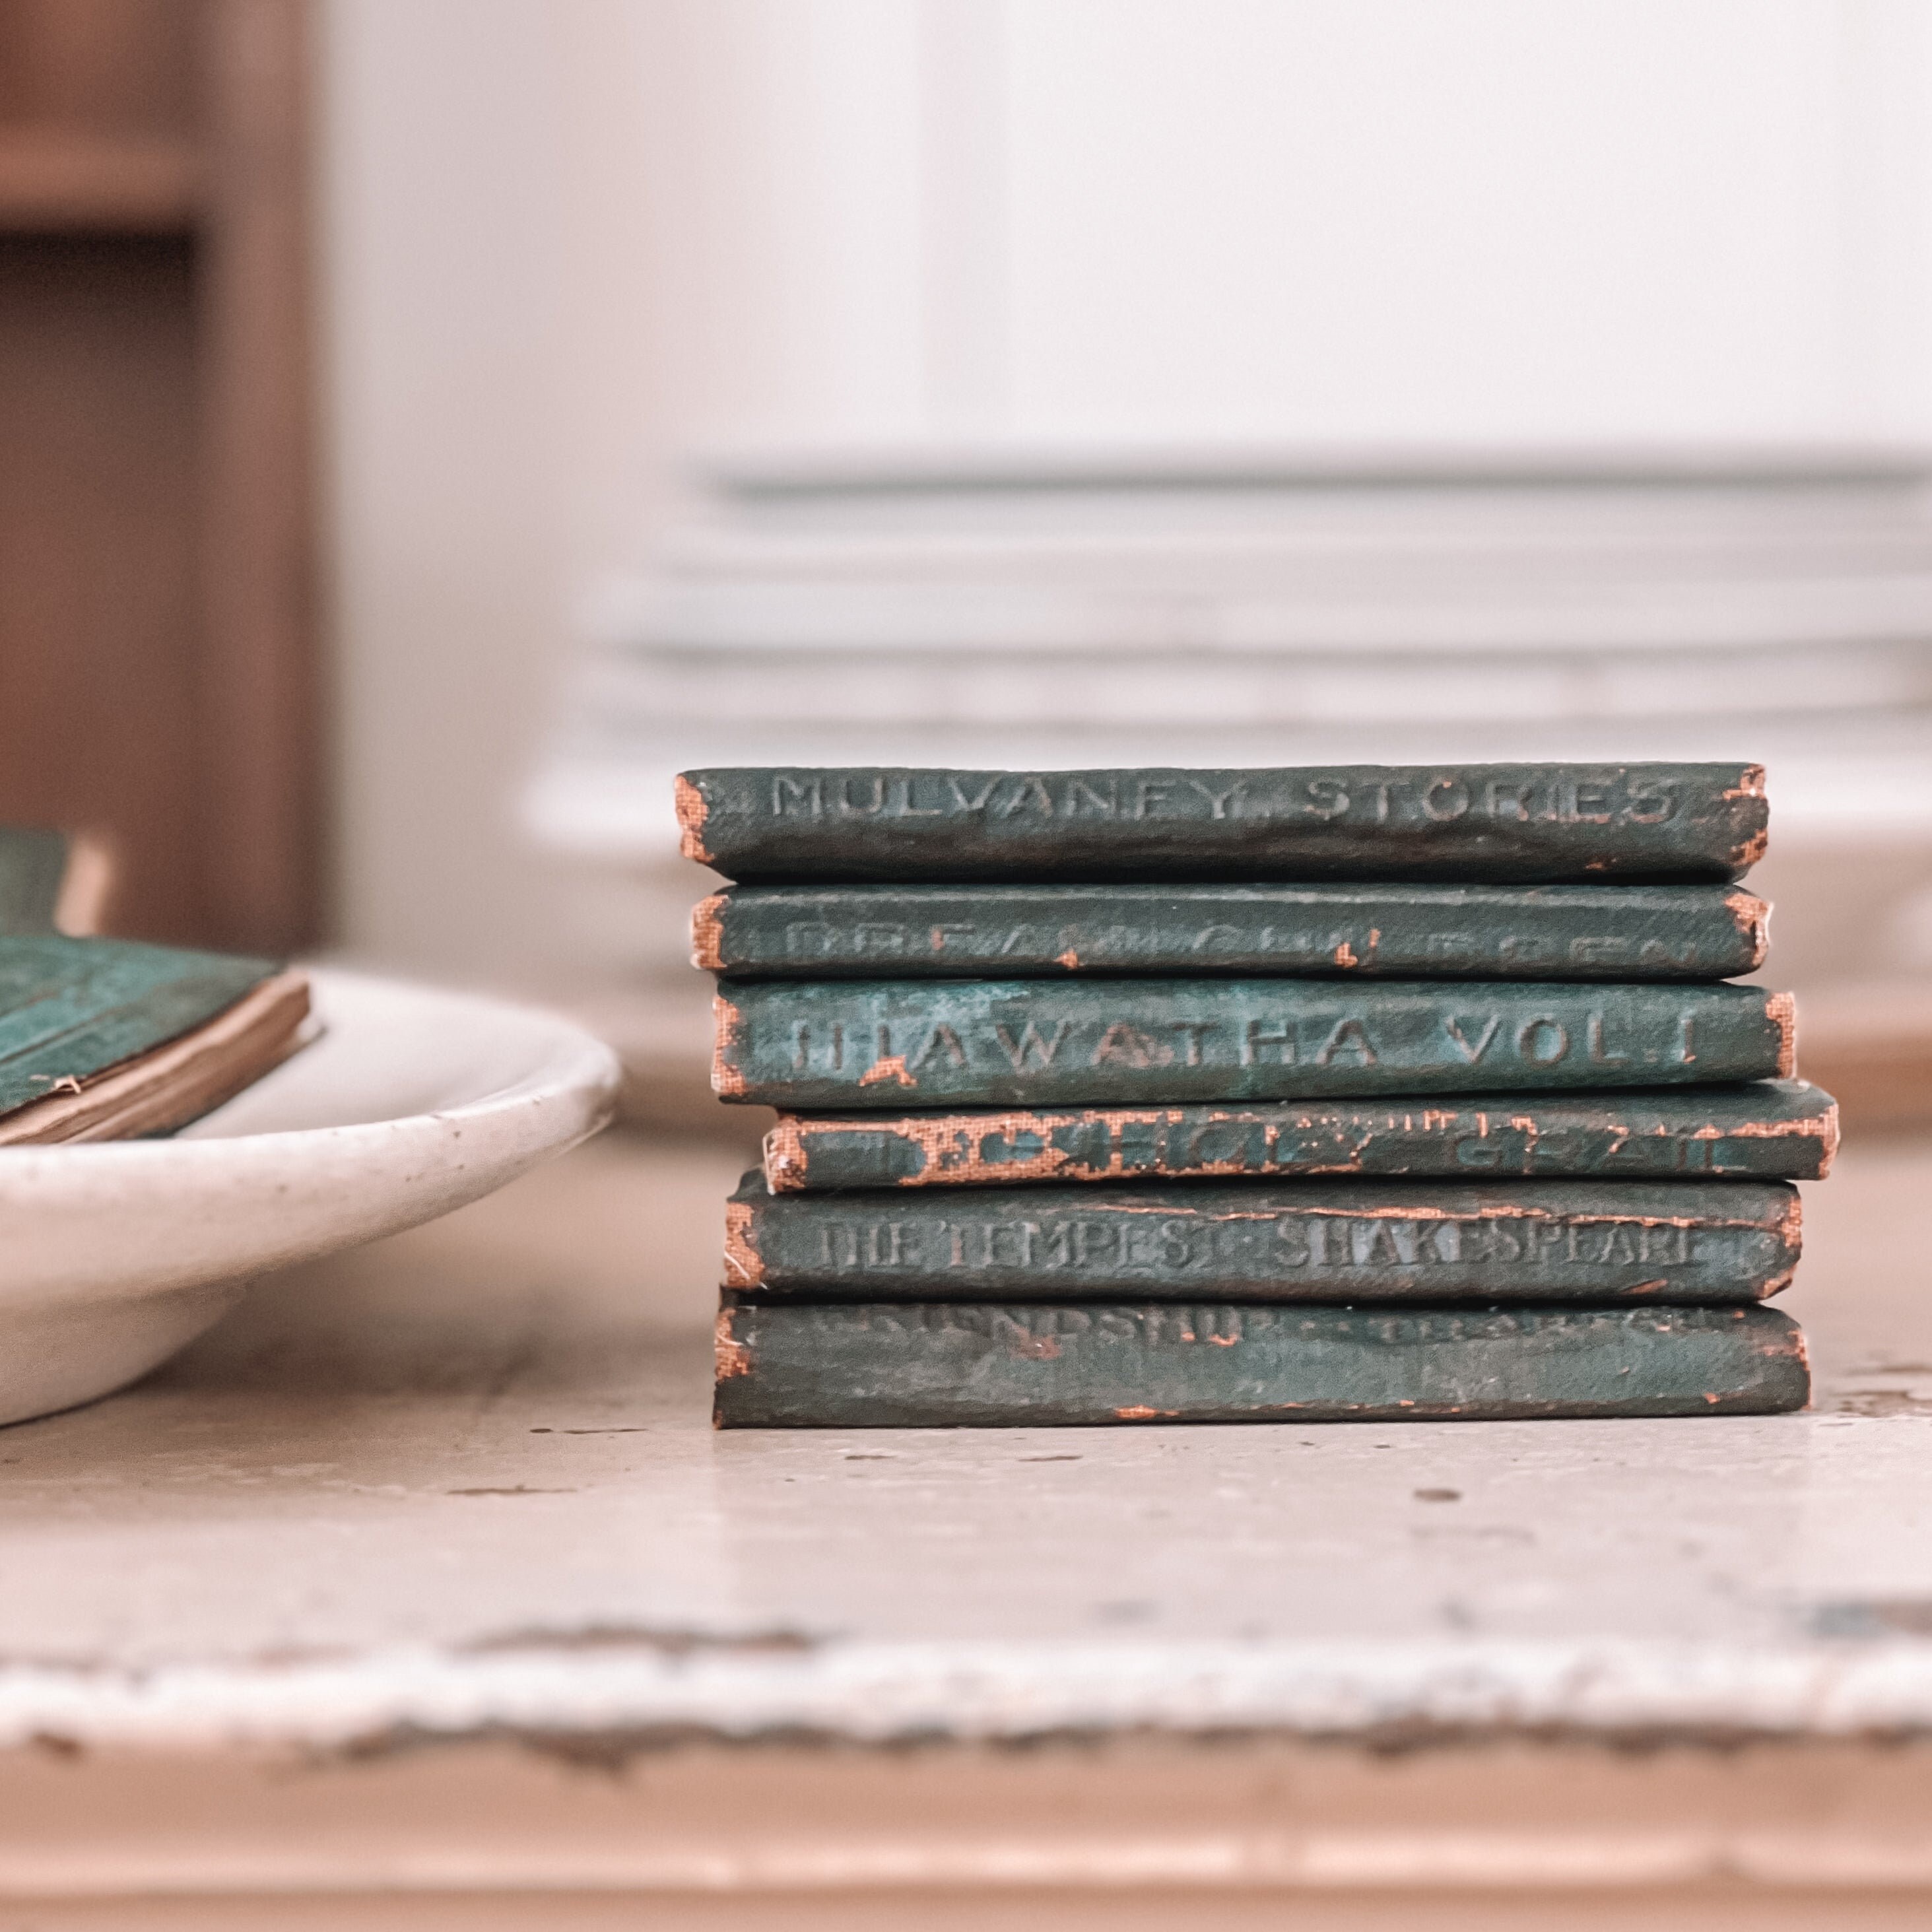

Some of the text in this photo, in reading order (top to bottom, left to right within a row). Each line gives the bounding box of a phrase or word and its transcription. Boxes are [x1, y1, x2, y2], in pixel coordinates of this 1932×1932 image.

[771, 772, 1678, 824] MULVANEY STORIES
[792, 1016, 1378, 1071] HIAWATHA
